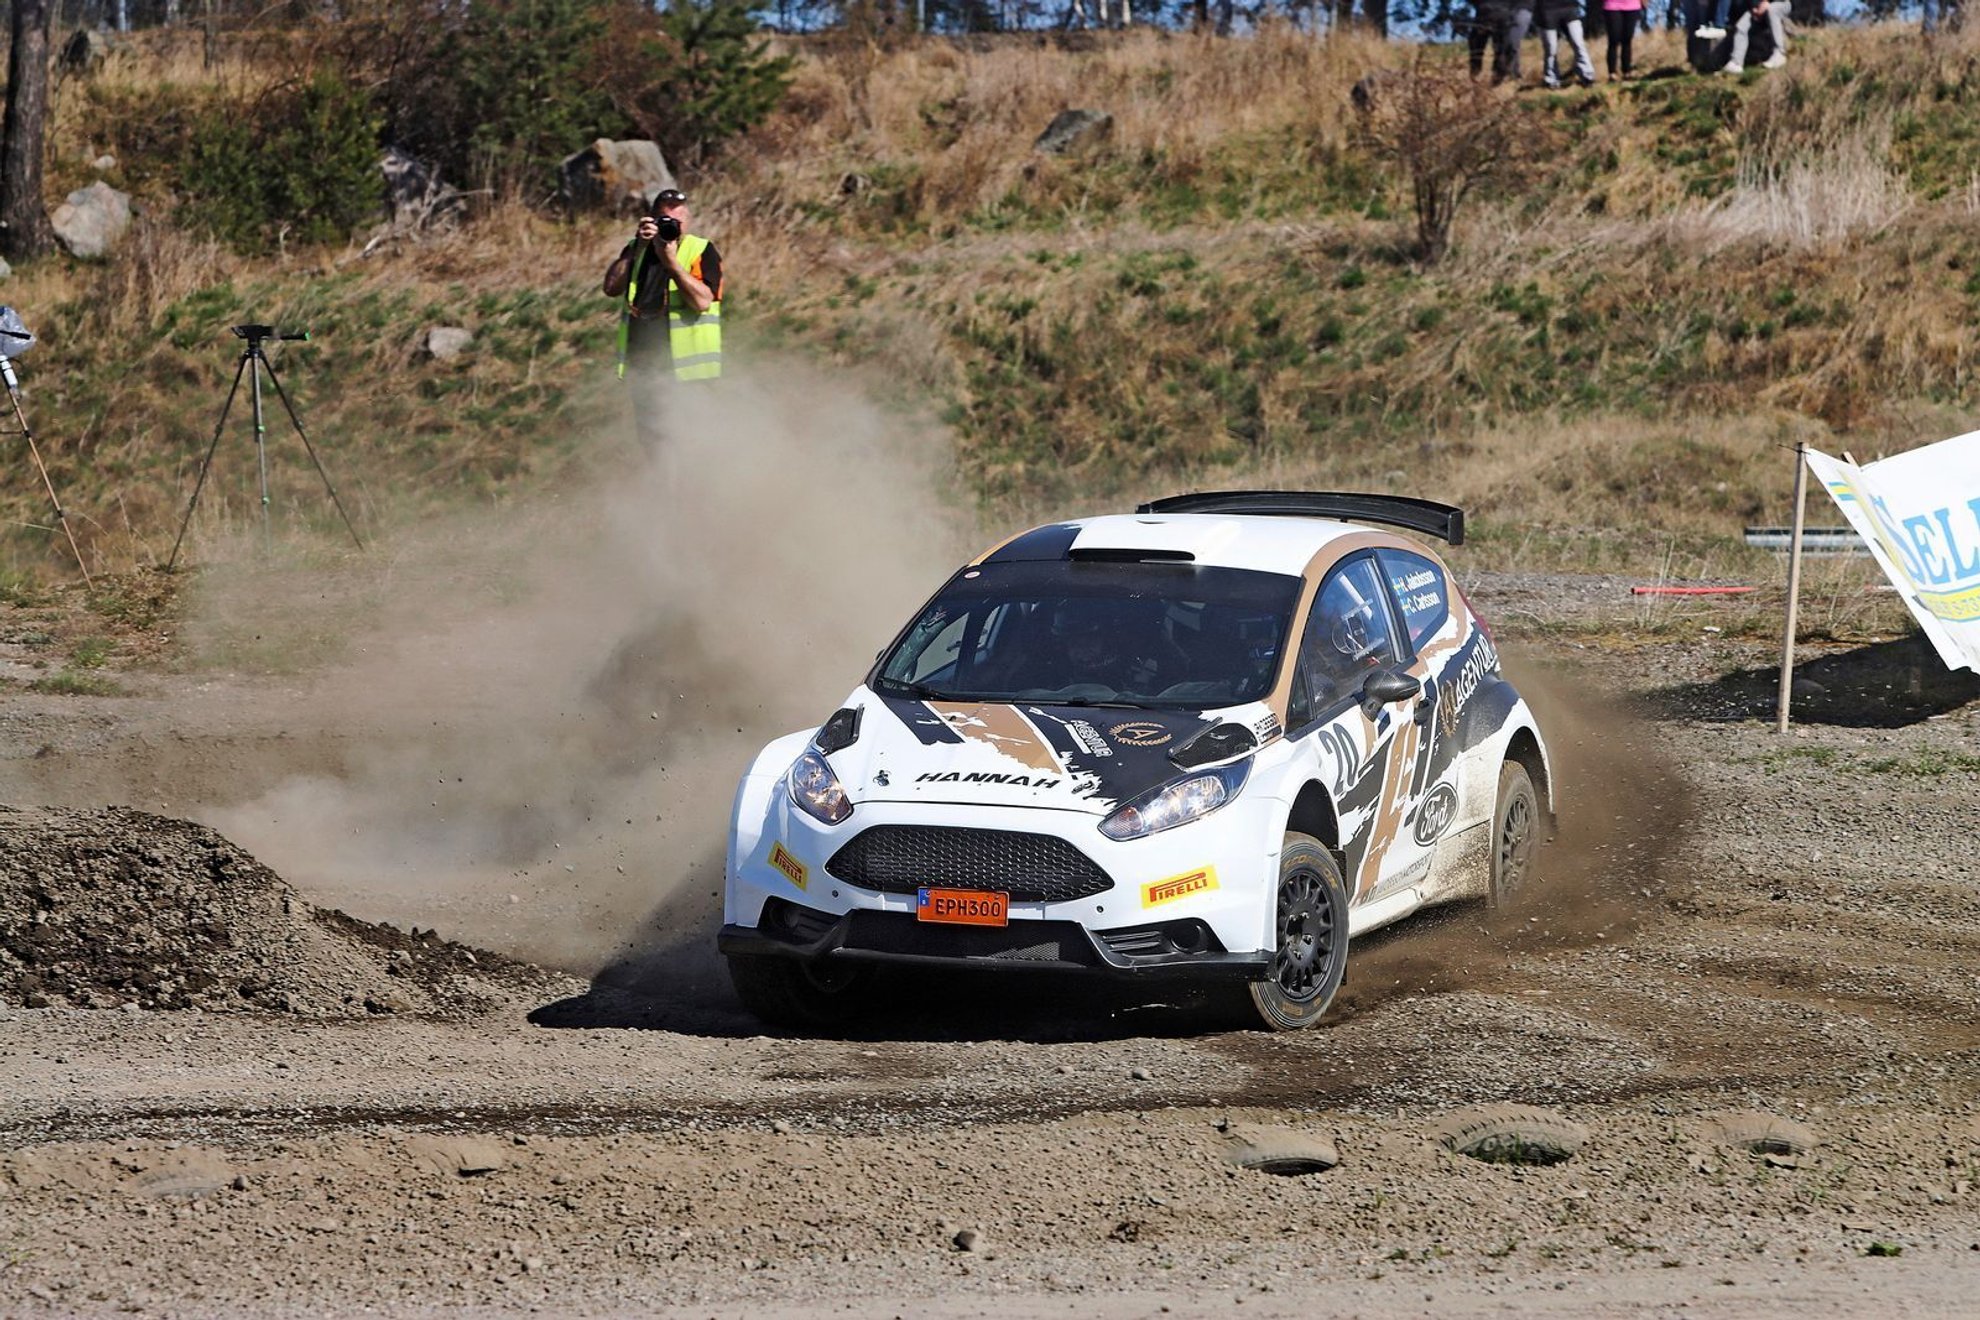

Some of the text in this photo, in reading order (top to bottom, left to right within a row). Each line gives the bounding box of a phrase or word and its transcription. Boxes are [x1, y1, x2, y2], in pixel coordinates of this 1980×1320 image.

[1318, 723, 1359, 796] 20
[915, 772, 1060, 788] HANNAH
[1420, 795, 1448, 839] Ford
[774, 848, 802, 883] PIRELLI
[1149, 872, 1207, 902] PIRELLI
[935, 898, 1001, 917] EPH300
